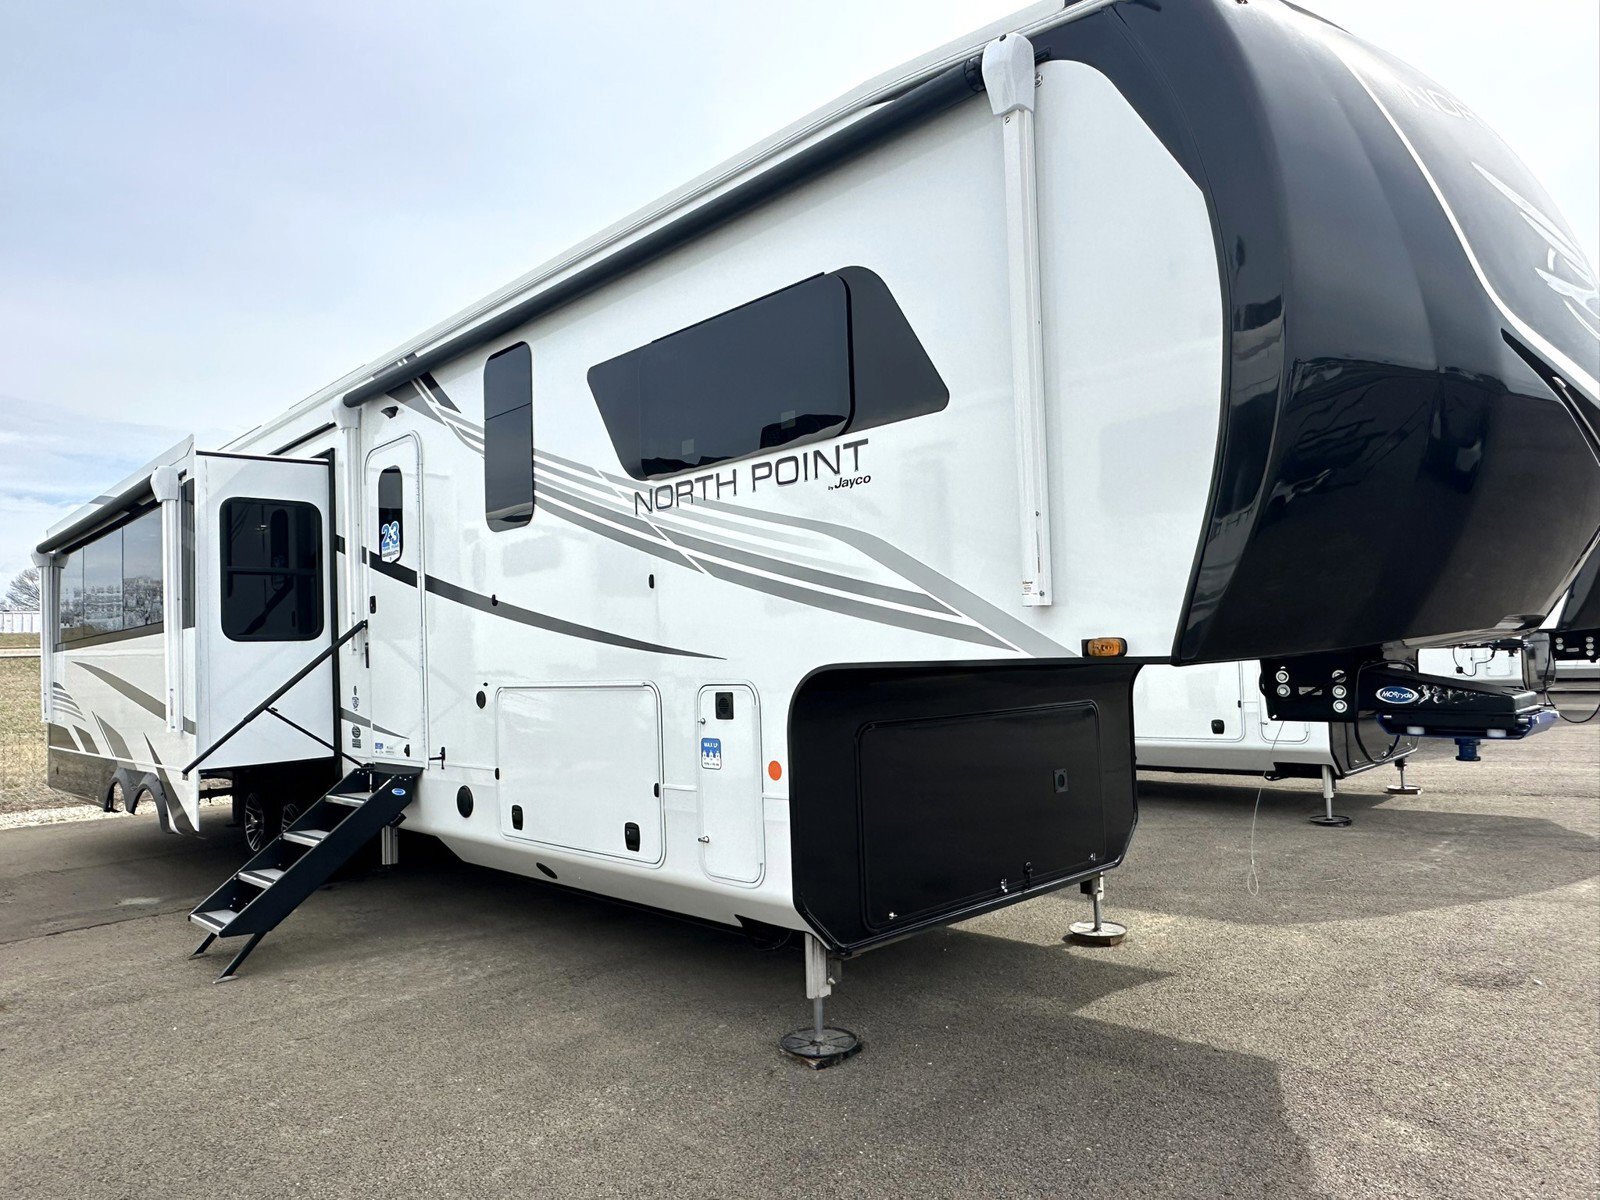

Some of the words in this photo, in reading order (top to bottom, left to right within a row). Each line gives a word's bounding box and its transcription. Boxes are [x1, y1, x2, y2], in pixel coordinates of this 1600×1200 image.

[1397, 83, 1484, 127] NOR
[634, 469, 737, 515] NORTH
[751, 438, 869, 492] POINT
[834, 475, 871, 489] Jayco
